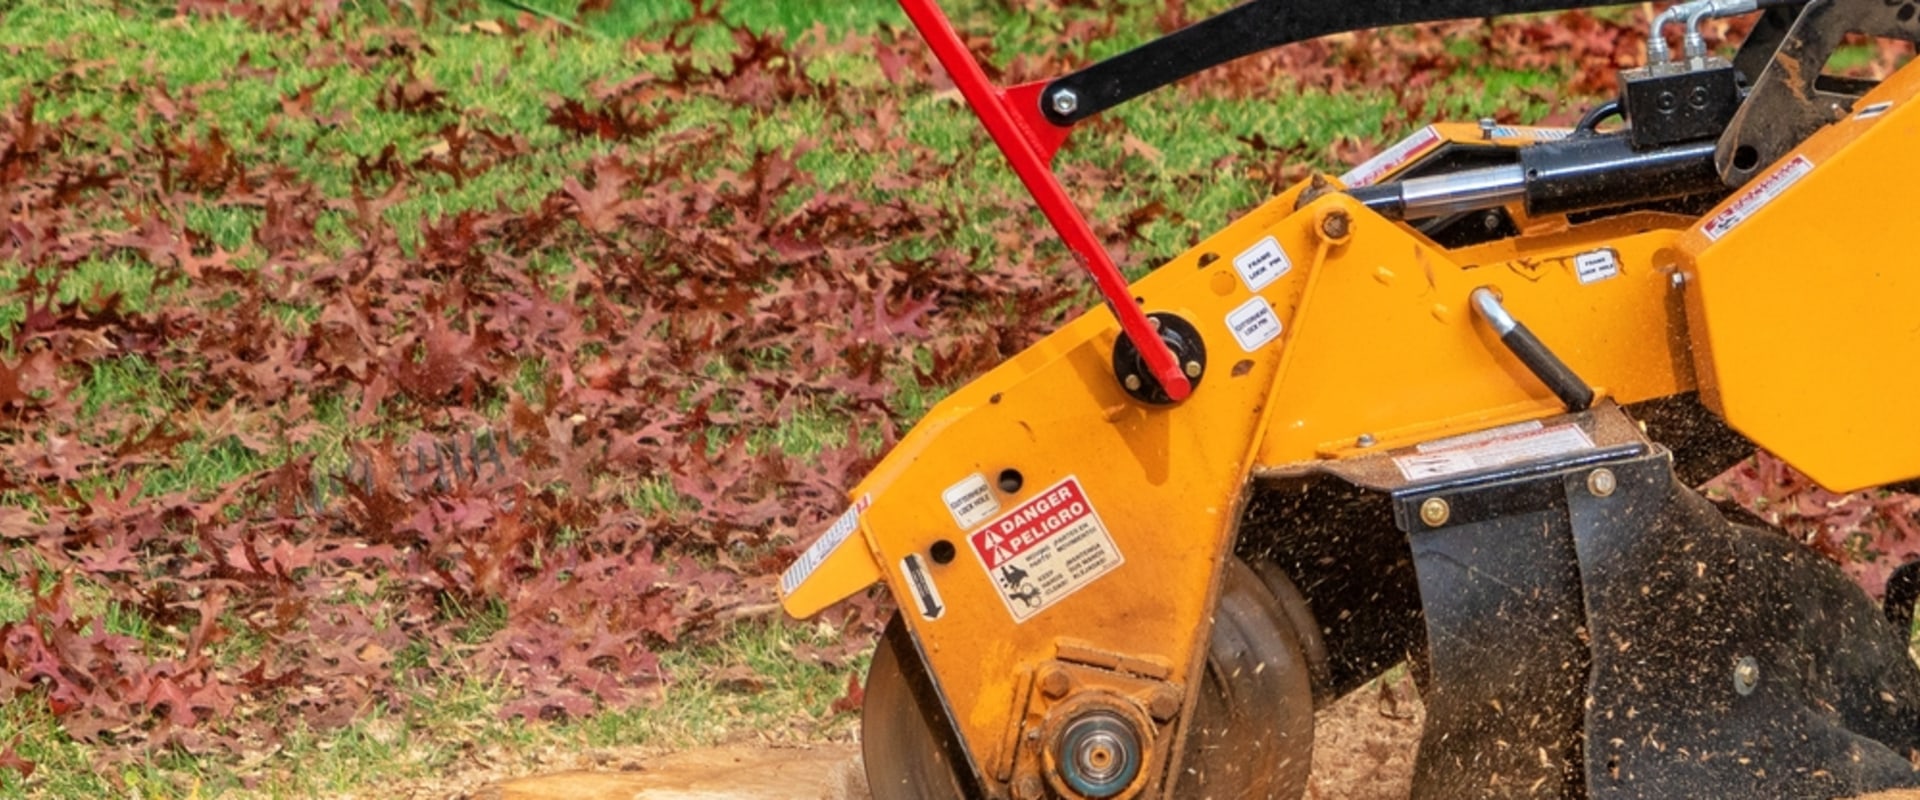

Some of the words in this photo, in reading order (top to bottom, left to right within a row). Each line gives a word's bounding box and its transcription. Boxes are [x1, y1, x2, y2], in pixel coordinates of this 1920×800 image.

[1247, 251, 1272, 269] FRAME
[1247, 265, 1267, 280] LOCK
[1268, 256, 1282, 267] PIN
[957, 502, 974, 516] LOCK
[973, 493, 990, 507] HOLE
[998, 485, 1074, 536] DANGER
[1008, 500, 1086, 552] PELIGRO
[1078, 522, 1089, 531] EN
[1036, 569, 1055, 583] KEEP
[1040, 573, 1064, 589] HANDS
